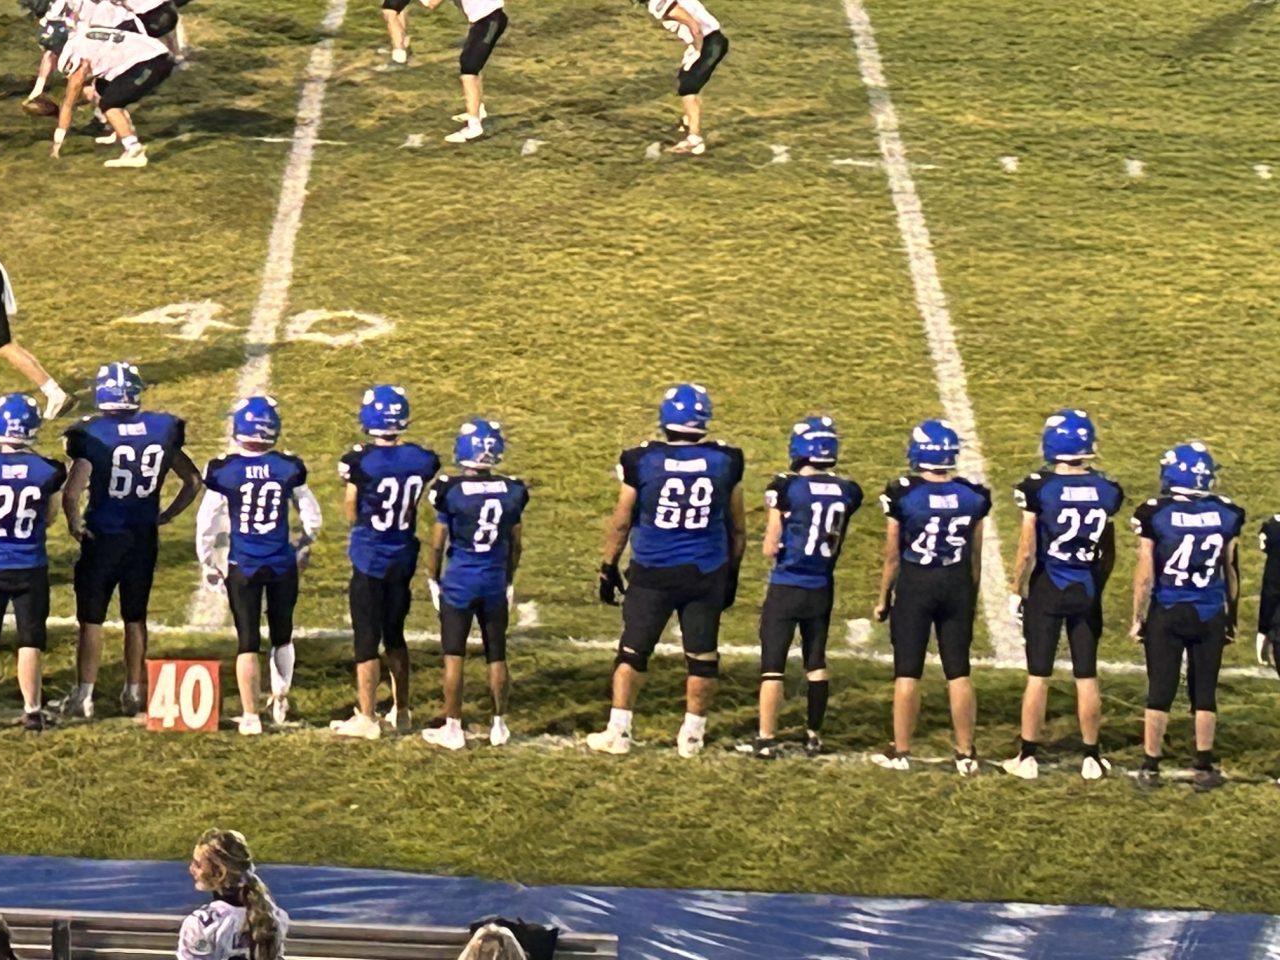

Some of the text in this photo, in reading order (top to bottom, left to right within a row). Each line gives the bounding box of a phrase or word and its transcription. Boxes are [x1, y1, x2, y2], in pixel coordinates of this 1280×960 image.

[108, 443, 167, 499] 69
[239, 481, 282, 534] 10
[370, 476, 424, 532] 30
[473, 498, 504, 552] 8
[653, 476, 714, 530] 68
[804, 501, 845, 558] 19
[910, 515, 972, 566] 45
[1046, 507, 1108, 561] 23
[1163, 533, 1224, 589] 43
[148, 663, 215, 730] 40
